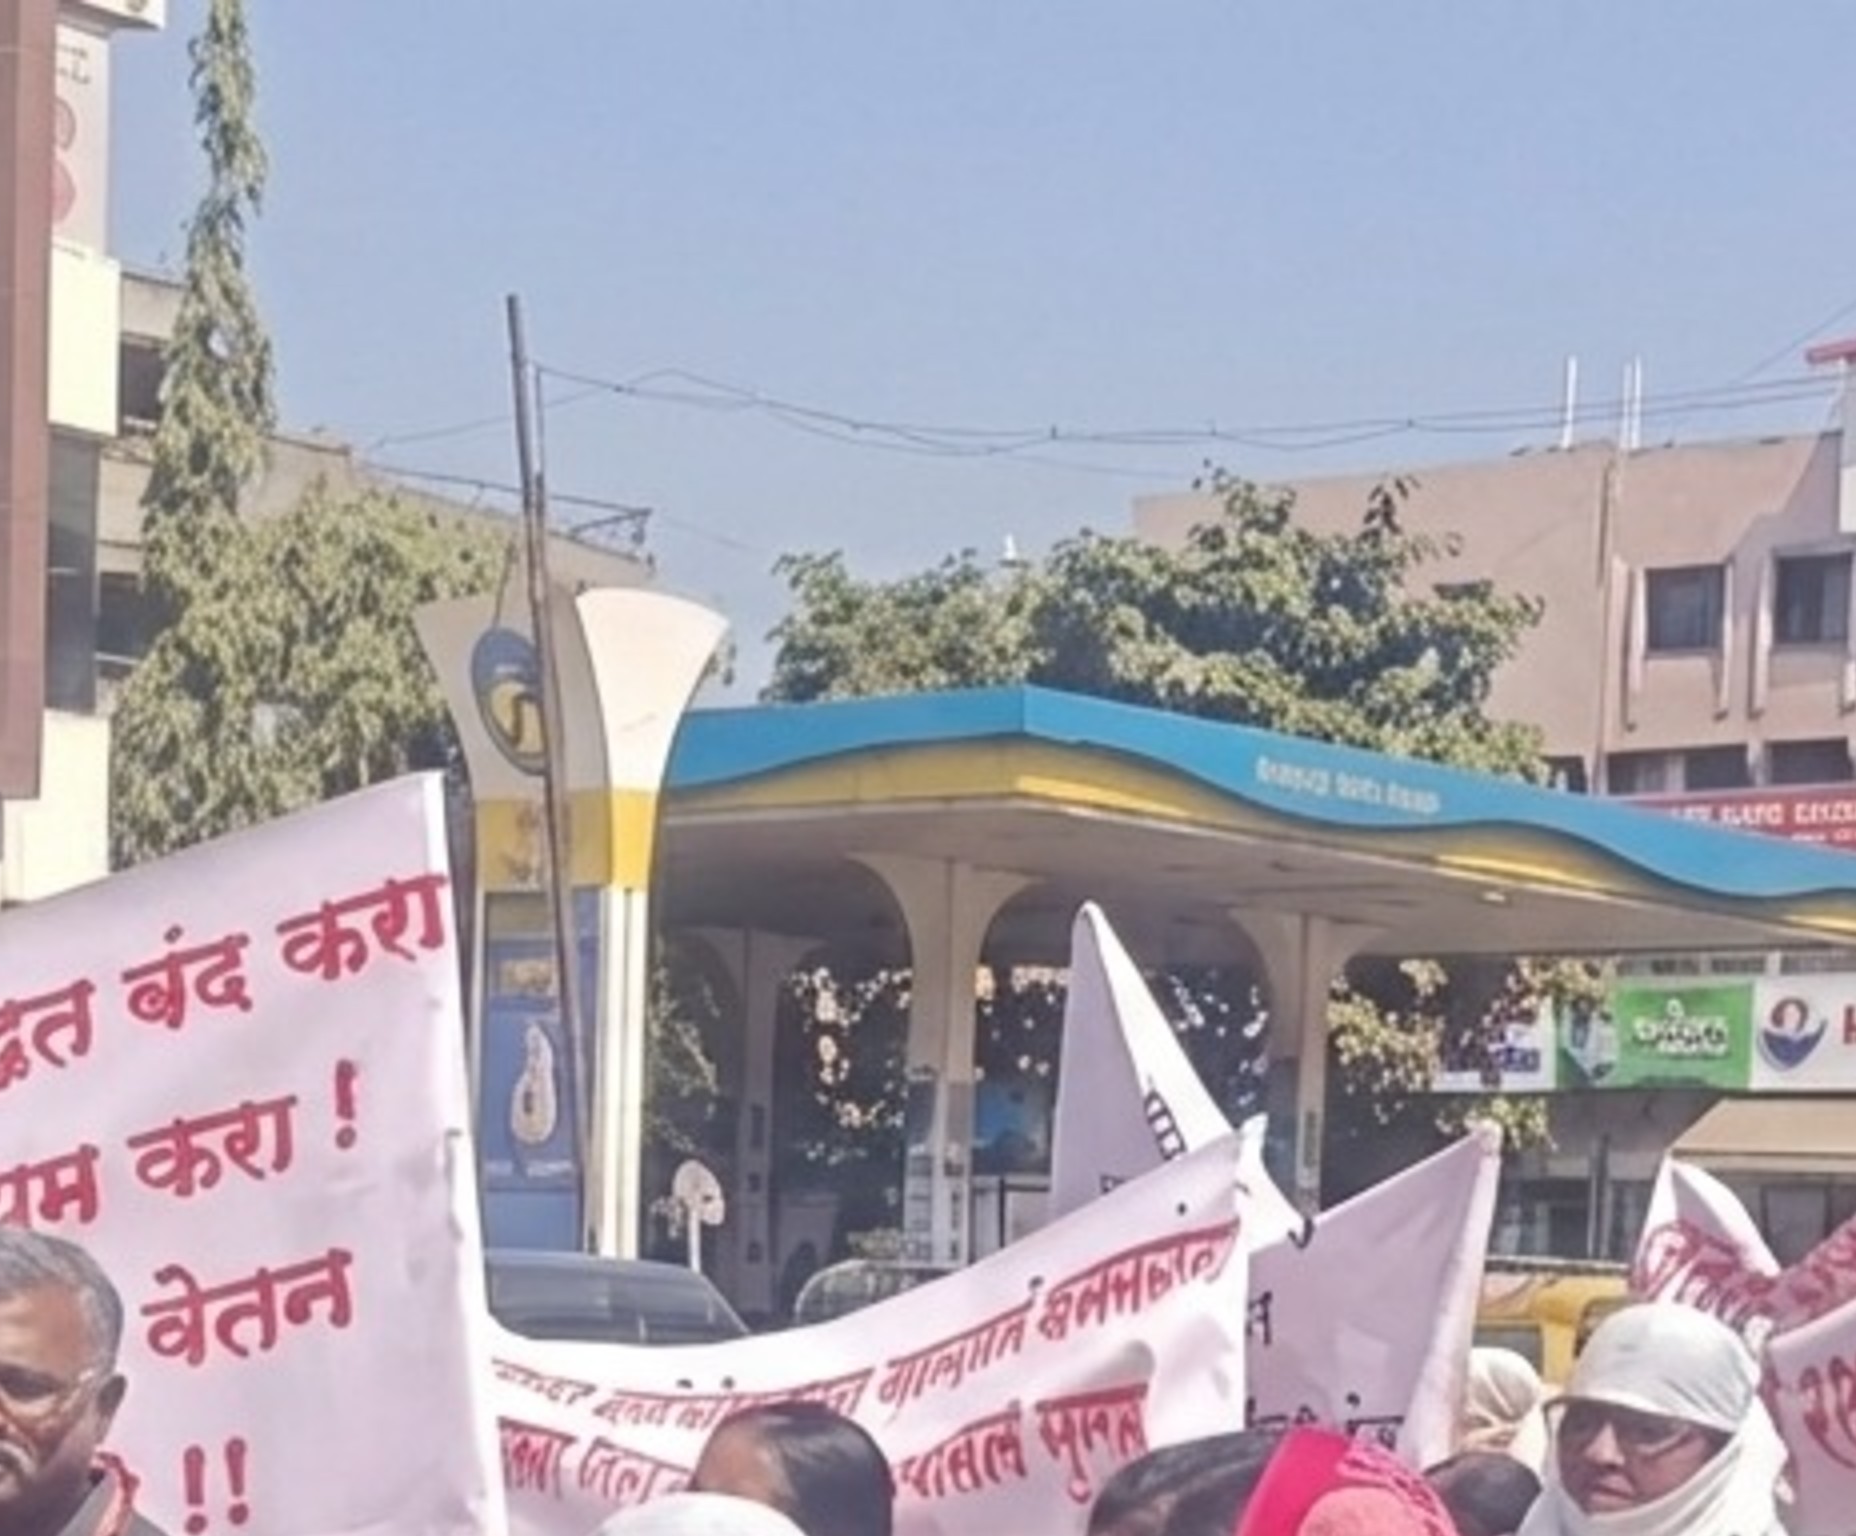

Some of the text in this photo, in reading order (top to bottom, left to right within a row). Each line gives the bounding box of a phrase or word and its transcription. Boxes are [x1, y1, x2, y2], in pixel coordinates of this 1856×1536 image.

[121, 924, 252, 1030] बंद
[275, 872, 448, 982] करा
[127, 1095, 299, 1198] करा
[140, 1248, 354, 1365] वेतन
